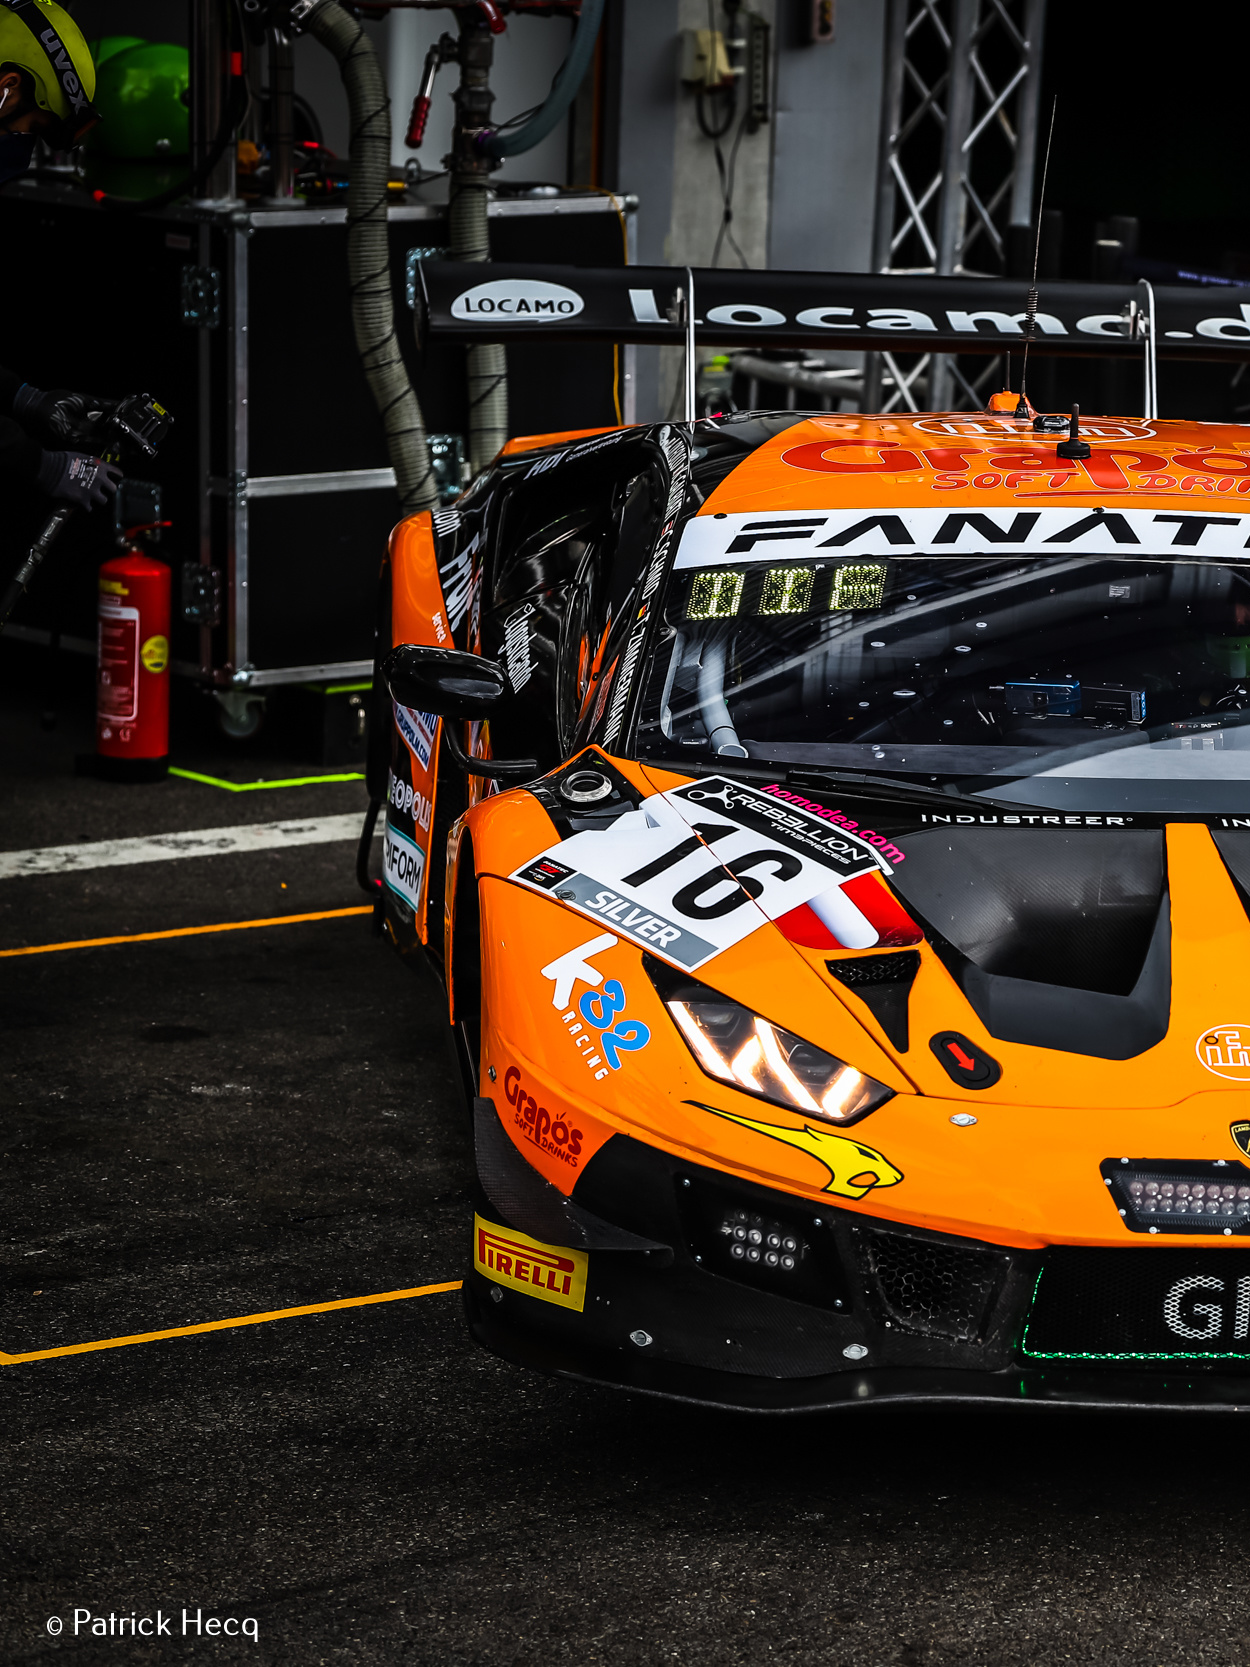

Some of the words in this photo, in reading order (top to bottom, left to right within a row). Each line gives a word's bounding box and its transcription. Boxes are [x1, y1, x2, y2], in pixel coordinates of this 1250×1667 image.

[40, 28, 89, 116] uvex
[463, 297, 575, 315] LOCAMO
[932, 470, 1087, 492] SOFT
[760, 783, 906, 865] homodea.com
[921, 814, 1126, 827] INDUSTREER
[620, 822, 803, 920] 16
[584, 890, 682, 949] SILVER
[562, 1009, 609, 1081] RACING
[513, 1113, 535, 1136] SOFT
[541, 1136, 578, 1168] DRINKS
[478, 1227, 575, 1296] PIRELLI
